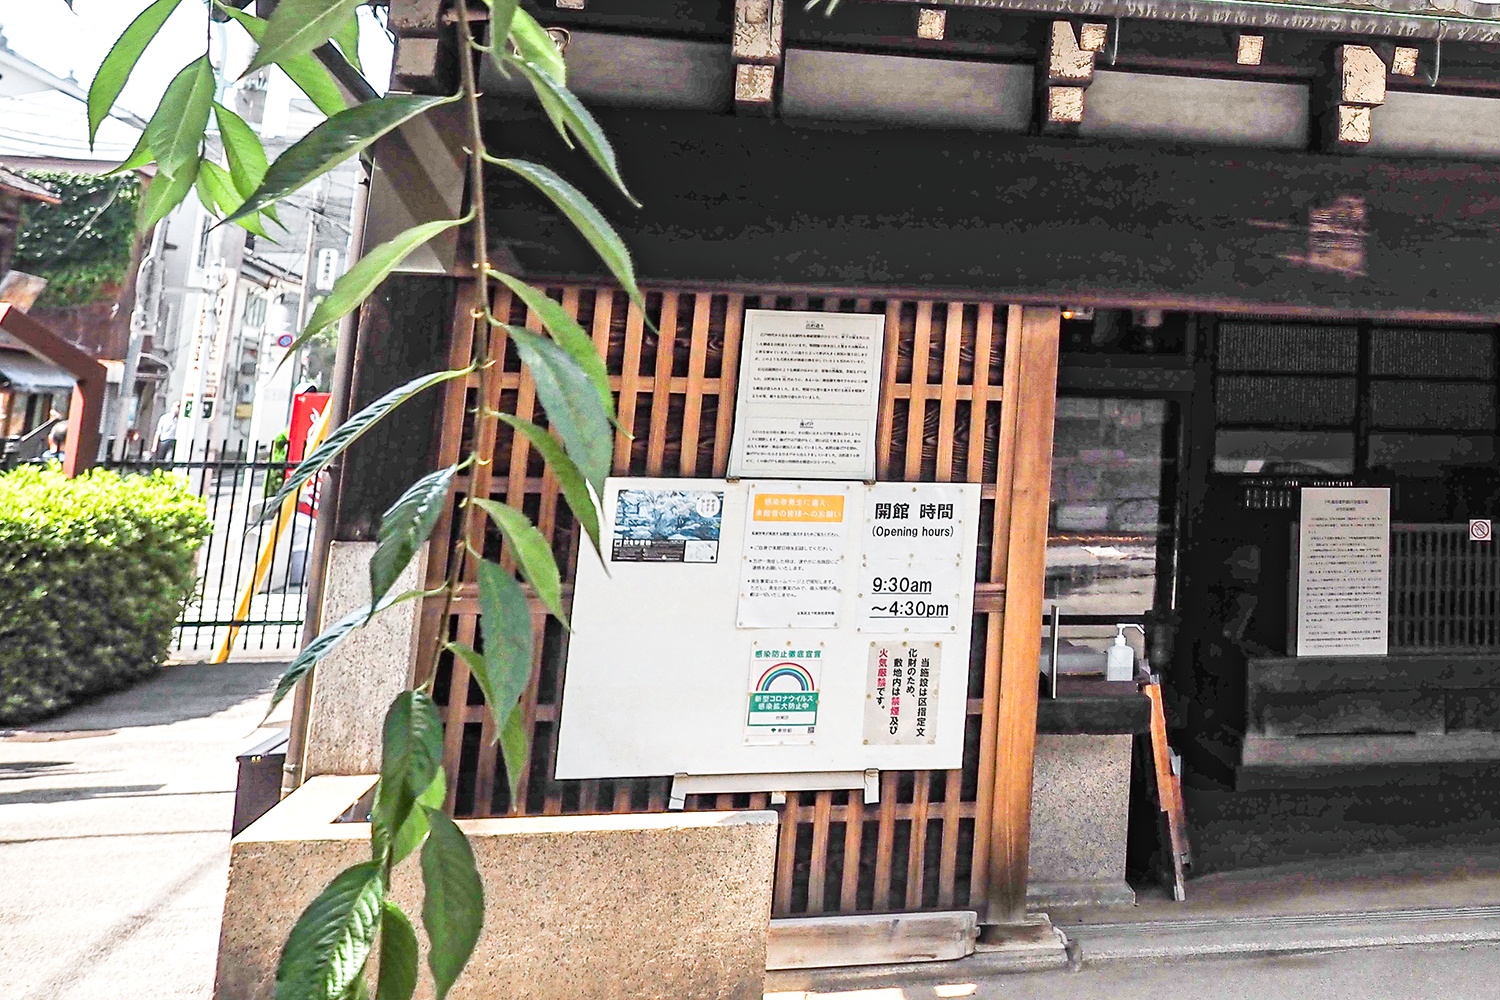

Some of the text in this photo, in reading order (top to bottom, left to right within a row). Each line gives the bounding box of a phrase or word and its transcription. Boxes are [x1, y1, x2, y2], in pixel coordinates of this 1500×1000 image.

[875, 503, 954, 520] 開館 時間
[872, 525, 954, 538] (Opening hours)
[872, 577, 932, 593] 9:30am
[755, 650, 822, 659] 感染防止徹底宣言
[876, 648, 889, 710] 火気厳禁です。
[906, 648, 918, 698] 化財のため、
[754, 695, 814, 703] 新型コロナウイルス
[889, 658, 904, 735] 敷地内は禁煙及び
[916, 658, 930, 738] 当施設は区指定文
[758, 702, 810, 710] 感染拡大防止中
